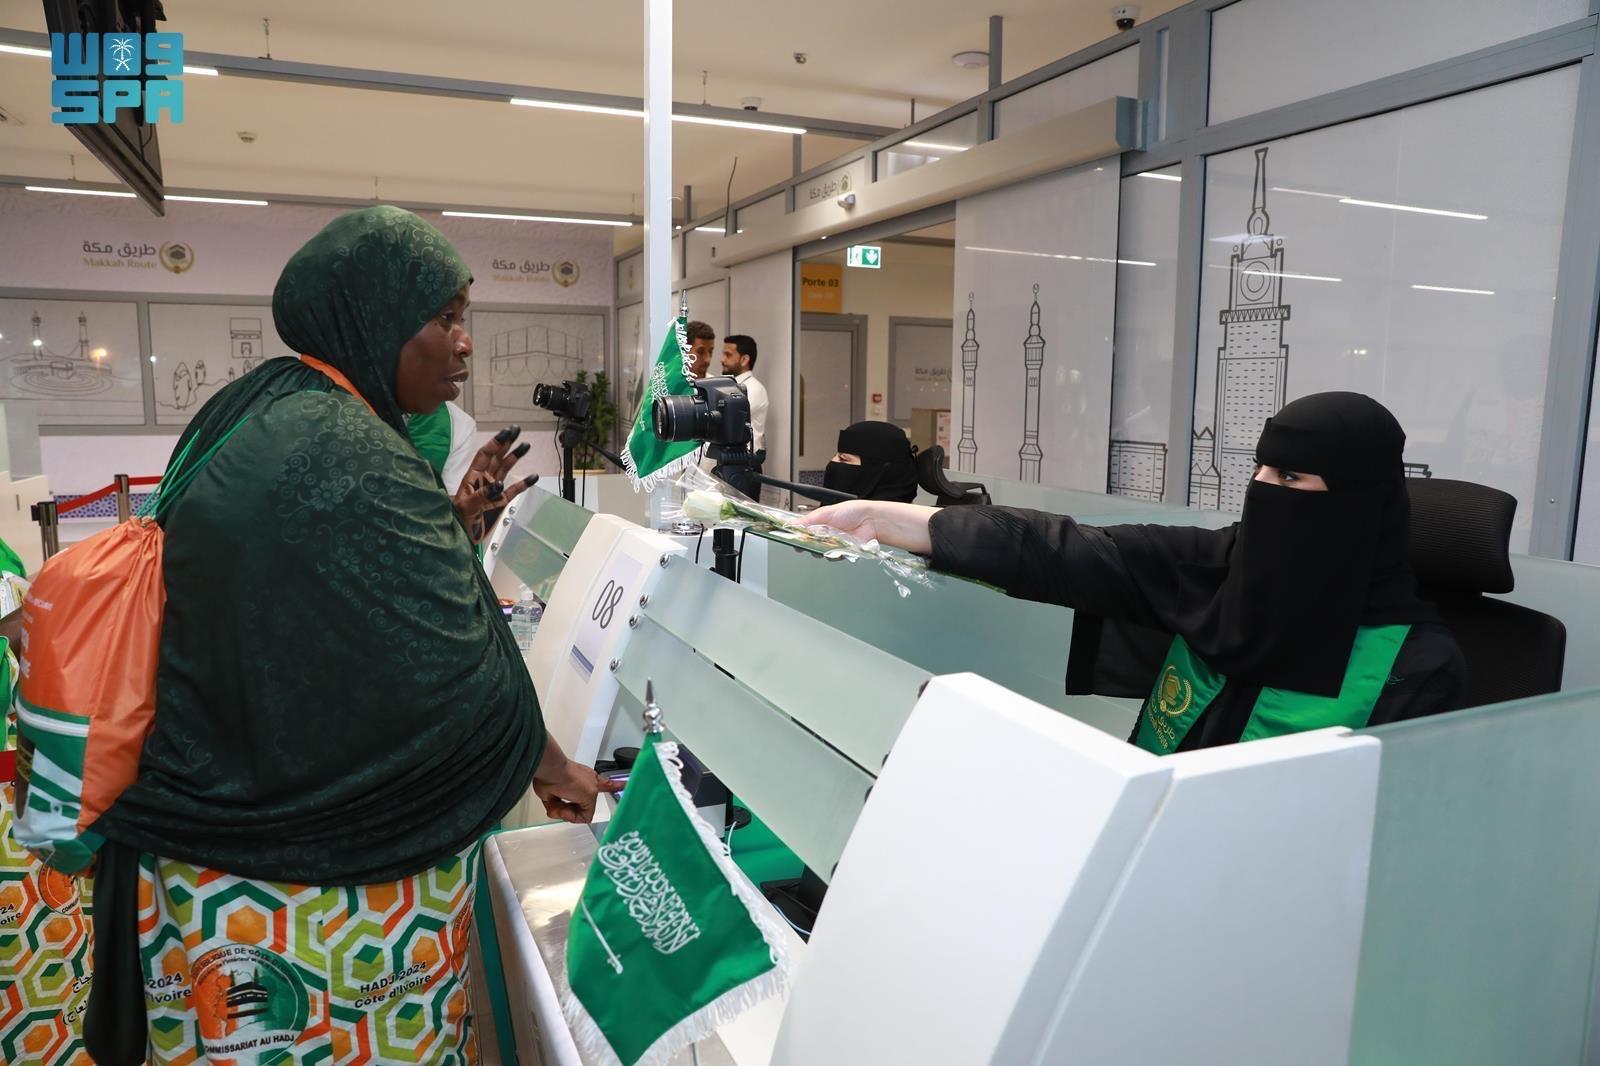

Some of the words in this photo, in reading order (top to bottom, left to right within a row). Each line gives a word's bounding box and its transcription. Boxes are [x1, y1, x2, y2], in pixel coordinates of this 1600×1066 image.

[82, 241, 113, 254] مكة
[117, 243, 156, 258] طريق
[491, 259, 517, 271] مكة
[519, 261, 551, 274] طريق
[801, 277, 826, 287] Porte
[828, 279, 840, 288] 03
[592, 579, 624, 630] 08
[234, 947, 248, 956] DE
[148, 972, 182, 989] 2024
[360, 974, 395, 993] HADJ
[398, 961, 426, 980] 2024
[150, 988, 193, 1003] Ivoire
[354, 994, 386, 1009] Côte
[388, 974, 432, 999] d'Ivoire
[203, 1039, 258, 1055] OMMISSARIAT
[259, 1035, 271, 1047] AU
[272, 1033, 295, 1044] HADJ
